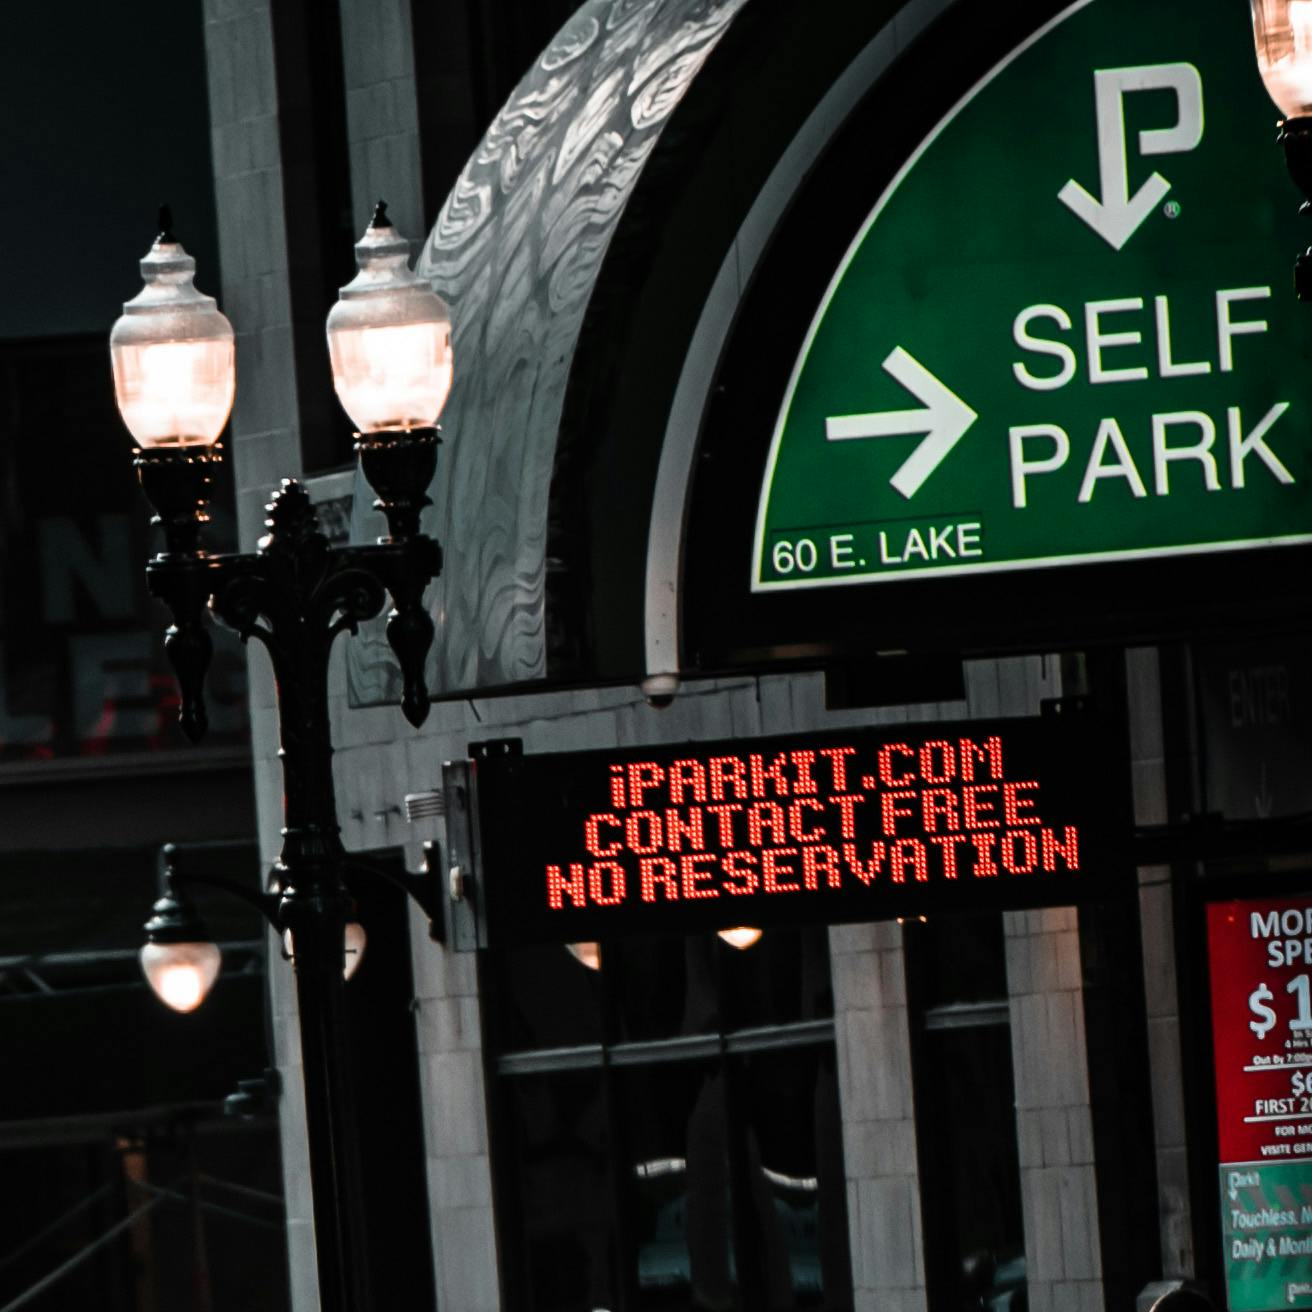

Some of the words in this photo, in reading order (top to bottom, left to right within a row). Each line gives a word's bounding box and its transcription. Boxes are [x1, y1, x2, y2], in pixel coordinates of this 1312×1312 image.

[1012, 286, 1272, 392] SELF
[1009, 401, 1296, 509] PARK
[772, 539, 818, 576] 60
[830, 534, 867, 569] E.
[880, 523, 983, 565] LAKE
[610, 736, 1004, 808] iPARKIT.COM
[586, 794, 865, 859] CONTACT
[881, 781, 1041, 836] FREE
[546, 861, 626, 909] NO
[640, 826, 1080, 903] RESERVATION
[1255, 1098, 1295, 1116] FIRST
[1231, 1237, 1264, 1263] Daily
[1266, 1237, 1276, 1257] &
